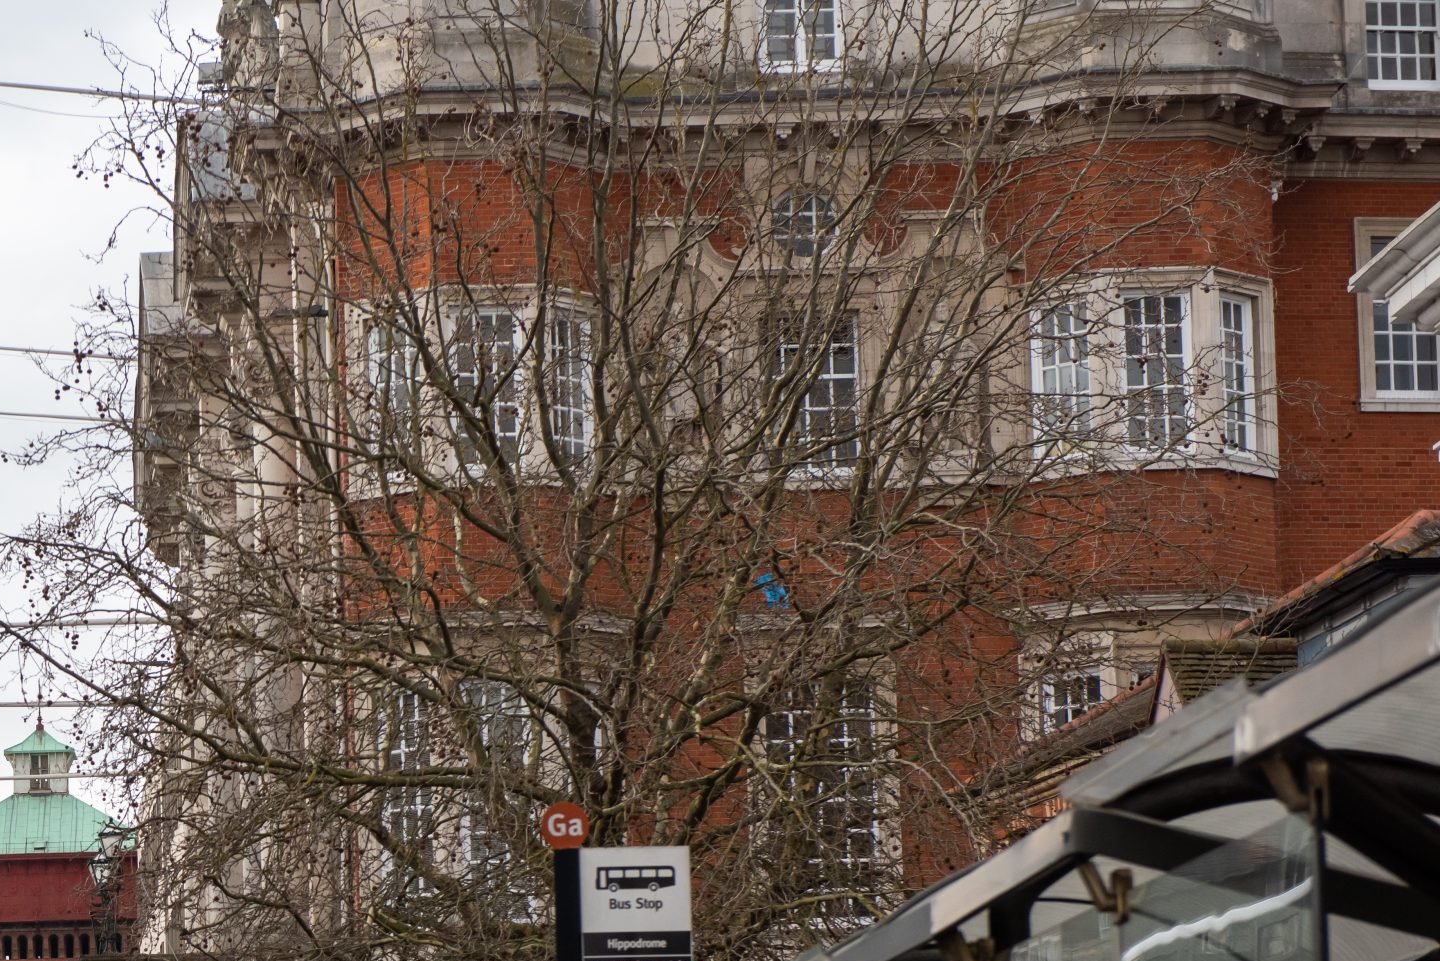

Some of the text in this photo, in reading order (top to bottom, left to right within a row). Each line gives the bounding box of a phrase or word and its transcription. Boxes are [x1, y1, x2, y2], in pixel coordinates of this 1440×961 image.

[547, 812, 584, 837] Ga
[609, 897, 663, 911] Bus Stop
[607, 938, 667, 951] Hippodrome
